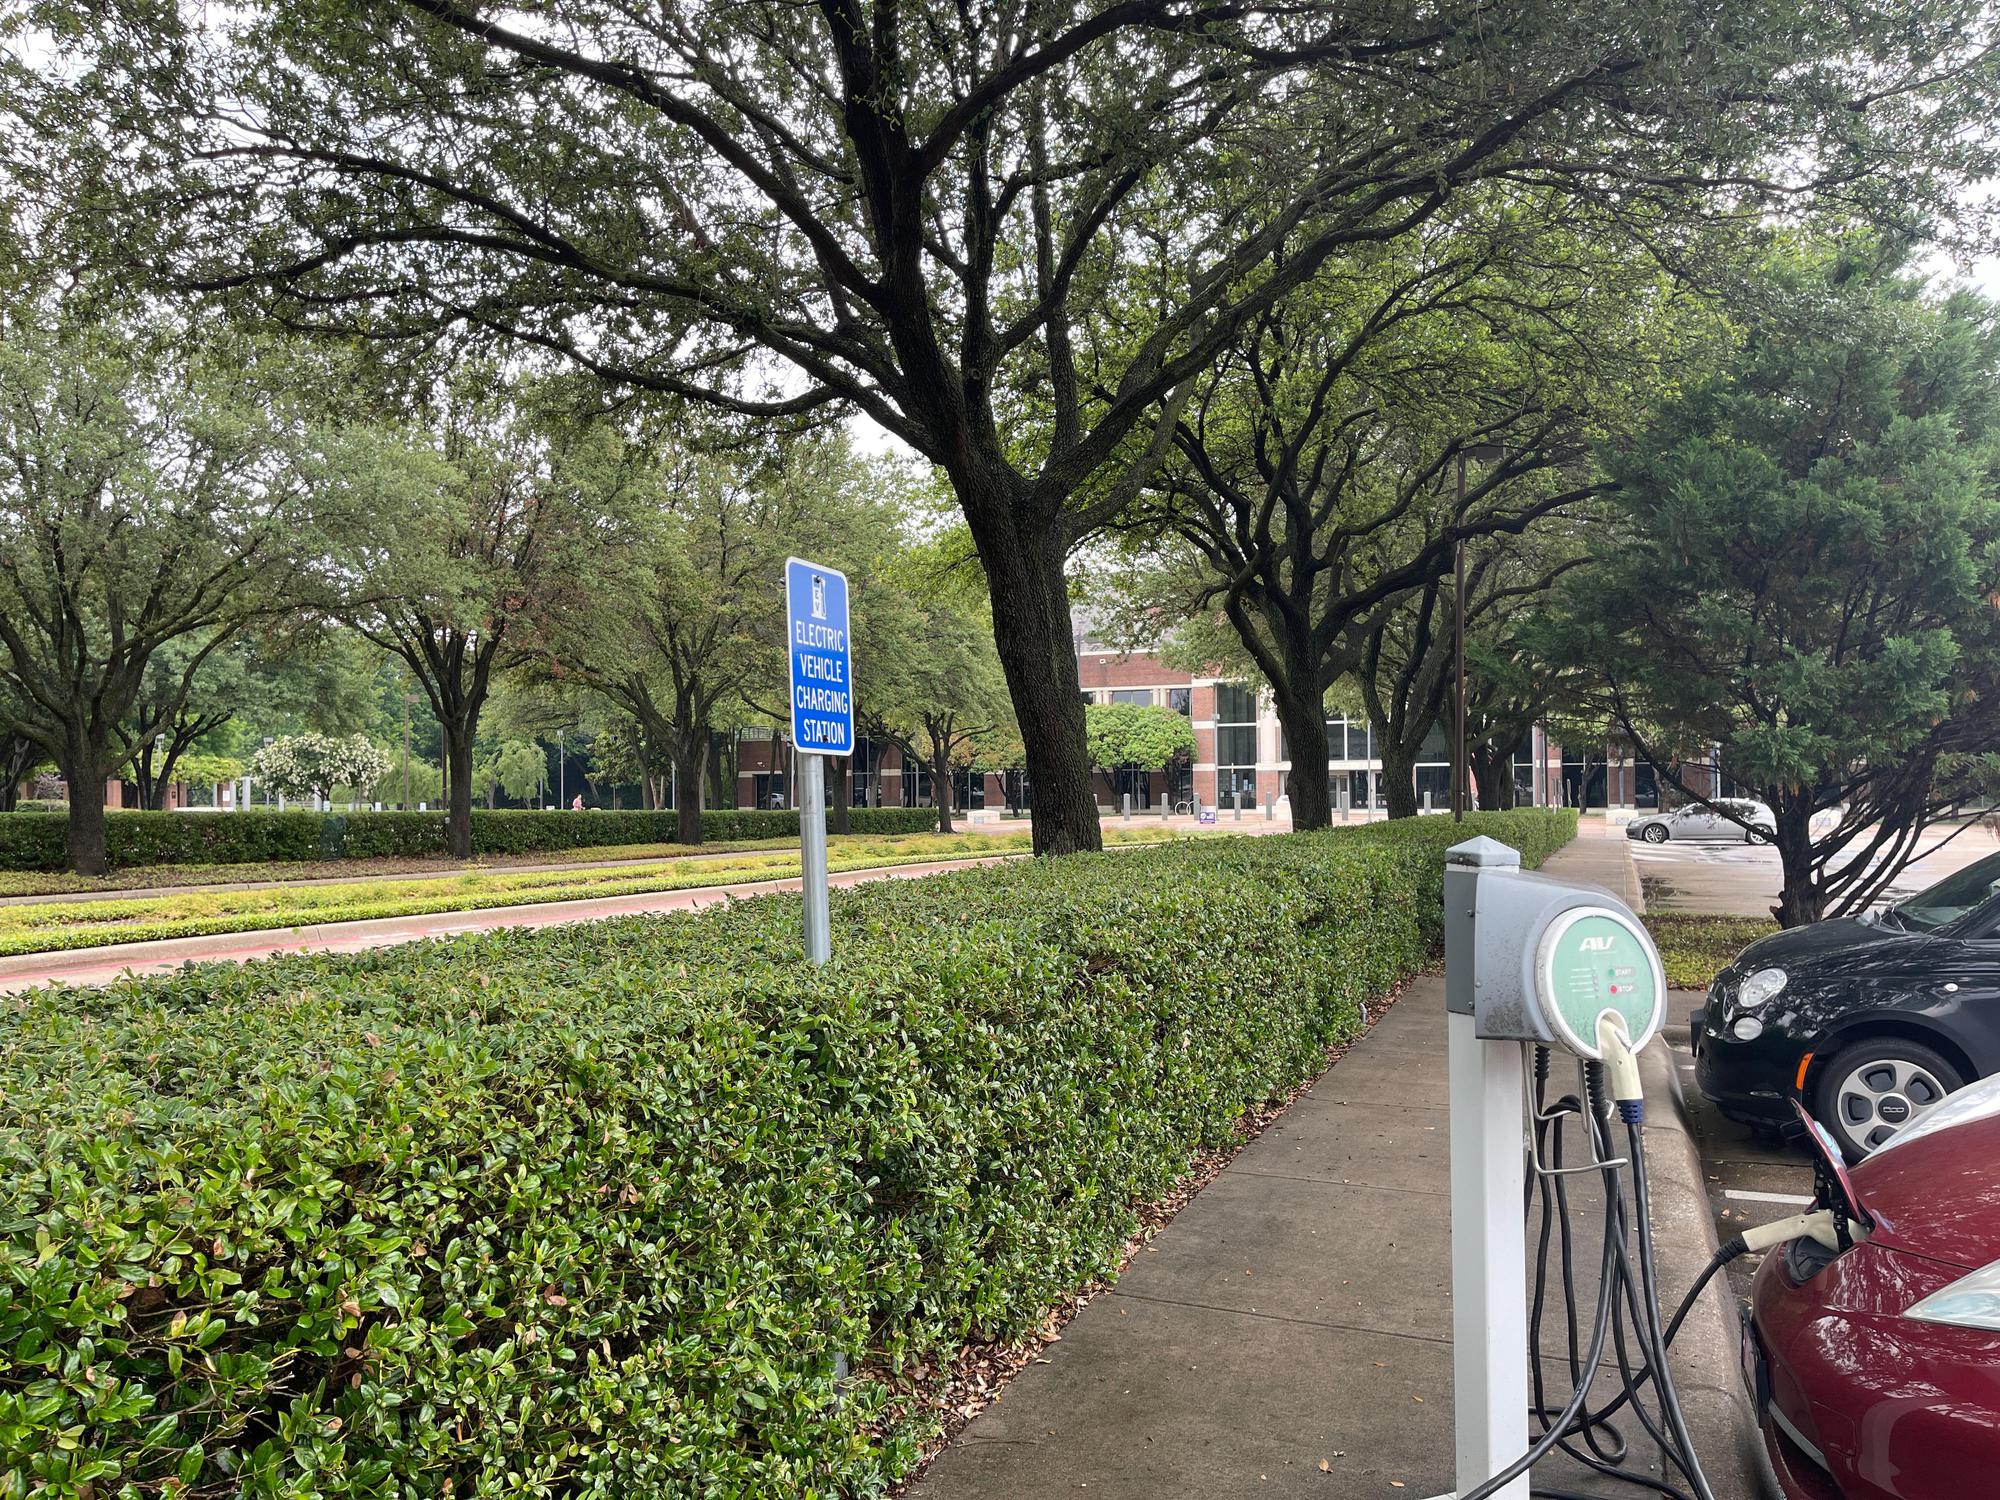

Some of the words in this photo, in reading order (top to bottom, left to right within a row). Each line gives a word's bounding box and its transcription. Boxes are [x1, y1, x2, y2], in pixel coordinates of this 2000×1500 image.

[796, 620, 844, 653] ELECTRIC
[800, 653, 843, 683] VEHICLE
[796, 685, 848, 715] CHARGING
[803, 718, 845, 745] STATION
[1578, 936, 1615, 952] AV
